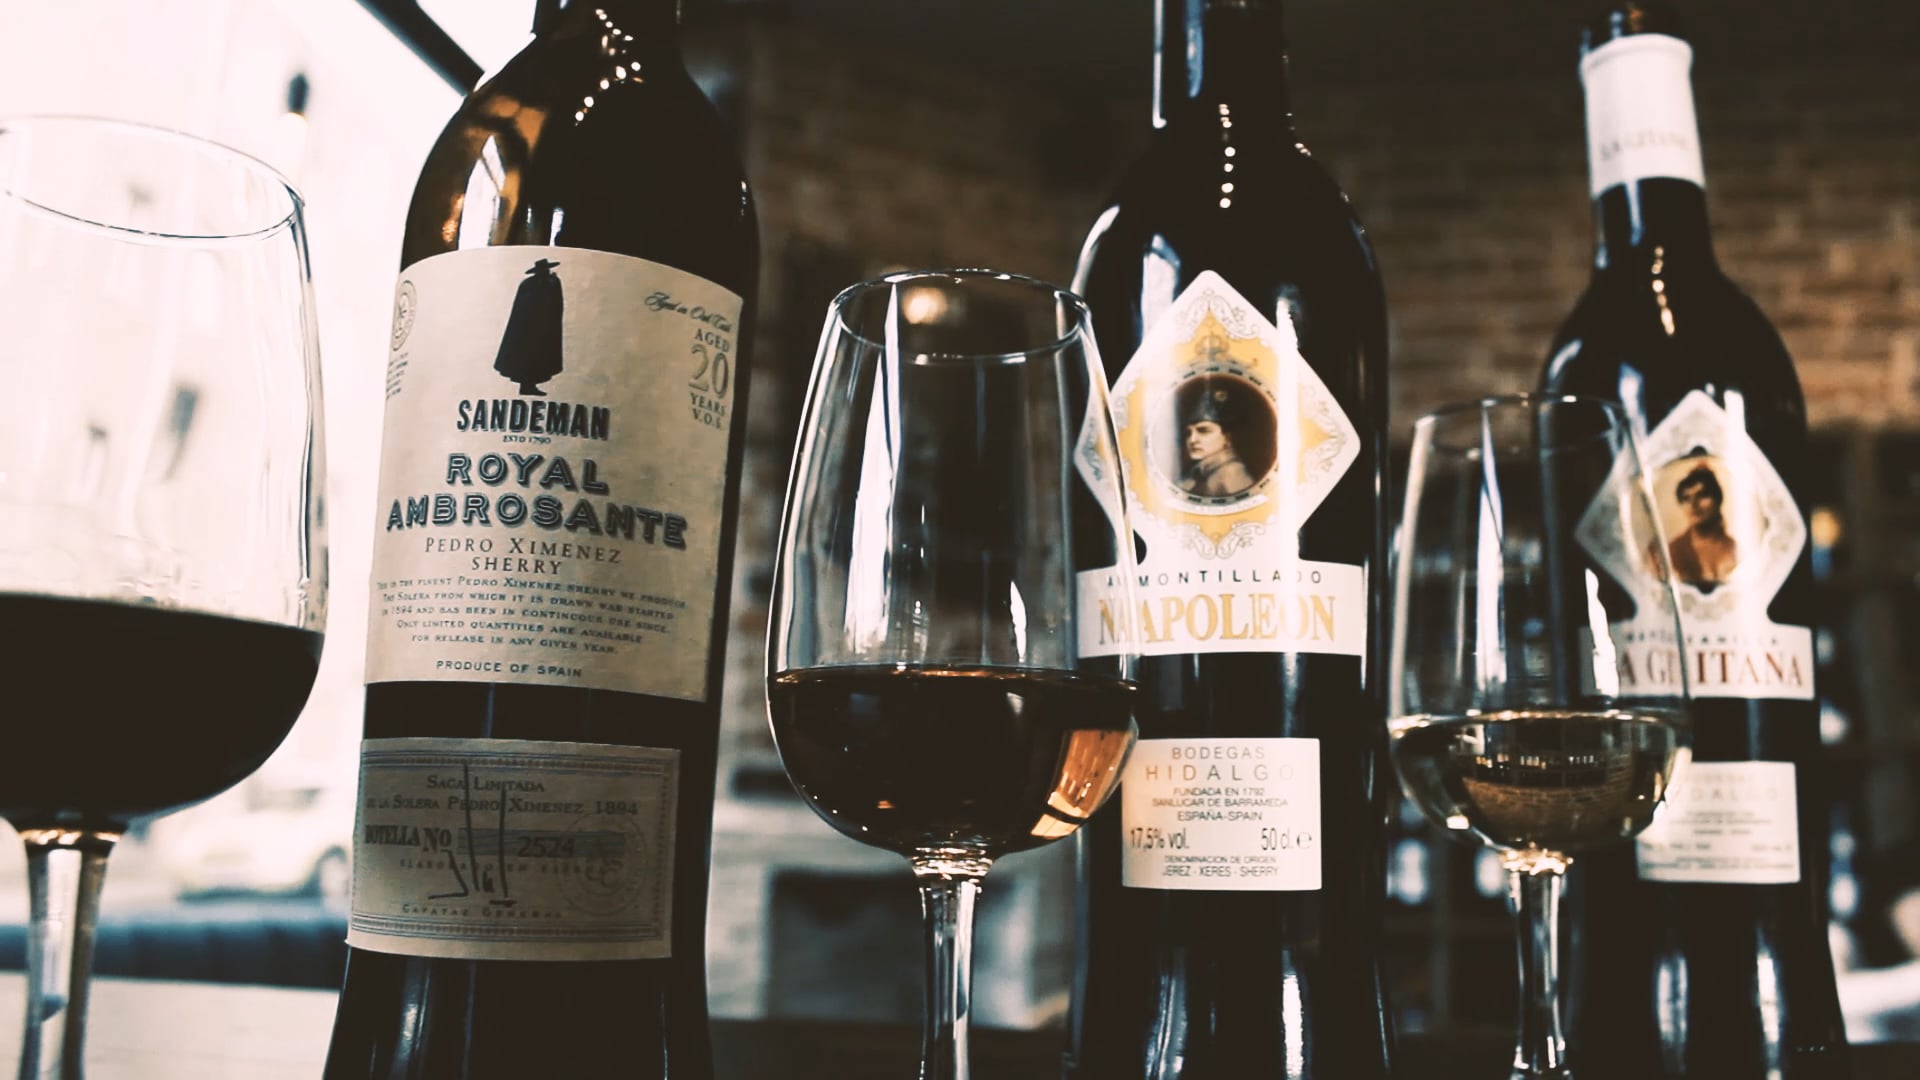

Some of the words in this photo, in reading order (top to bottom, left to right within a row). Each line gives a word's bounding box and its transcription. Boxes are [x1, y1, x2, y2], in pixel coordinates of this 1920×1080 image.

[695, 327, 730, 353] AGED
[688, 343, 729, 399] 20
[690, 392, 726, 417] YEARS
[456, 398, 611, 441] SANDEMAN
[446, 452, 610, 496] ROYAL
[386, 493, 689, 551] AMBROSANTE
[425, 537, 494, 554] PEDRO
[508, 537, 622, 564] XIMENEZ
[472, 556, 562, 576] SHERRY
[457, 575, 498, 586] PEDRO
[503, 577, 561, 591] XIMENEZ
[566, 582, 616, 597] SHERRY
[397, 591, 430, 600] SOLERA
[434, 592, 464, 600] FROM
[469, 592, 506, 601] WHICH
[512, 594, 524, 602] IT
[531, 595, 543, 603] IS
[550, 596, 593, 608] DRAWN
[598, 602, 623, 613] WAS
[627, 607, 675, 620] STARTED
[466, 607, 496, 615] BEEN
[502, 608, 515, 616] IN
[608, 617, 631, 628] USE
[1098, 593, 1336, 645] NAPOLEON
[422, 620, 465, 629] LIMITED
[470, 621, 545, 633] QUANTITIES
[550, 626, 575, 635] ARE
[580, 628, 644, 645] AVAILABLE
[435, 635, 484, 643] RELEASE
[491, 636, 503, 644] IN
[509, 637, 535, 647] ANY
[540, 639, 577, 649] GIVEN
[436, 660, 502, 672] PRODUCE
[510, 663, 529, 673] OF
[537, 664, 582, 678] SPAIN
[1171, 746, 1265, 760] BODEGAS
[1145, 764, 1294, 781] HIDALGO
[1152, 798, 1206, 807] SANLUCAR
[1207, 798, 1220, 807] DE
[1224, 798, 1289, 807] BARRAMEDA
[1173, 787, 1221, 796] FUNDADA
[1225, 787, 1239, 796] EN
[1243, 787, 1265, 796] 1792
[392, 794, 441, 809] SOLERA
[447, 795, 500, 811] PEDRO
[508, 798, 585, 815] XIMENEZ
[595, 800, 639, 816] 1894
[1130, 827, 1165, 851] 17,5%
[1261, 827, 1278, 851] 50
[1230, 855, 1241, 864] DE
[1243, 855, 1277, 864] ORIGEN
[1162, 865, 1192, 877] JEREZ
[1199, 866, 1232, 877] XERES
[1239, 866, 1279, 877] SHERRY
